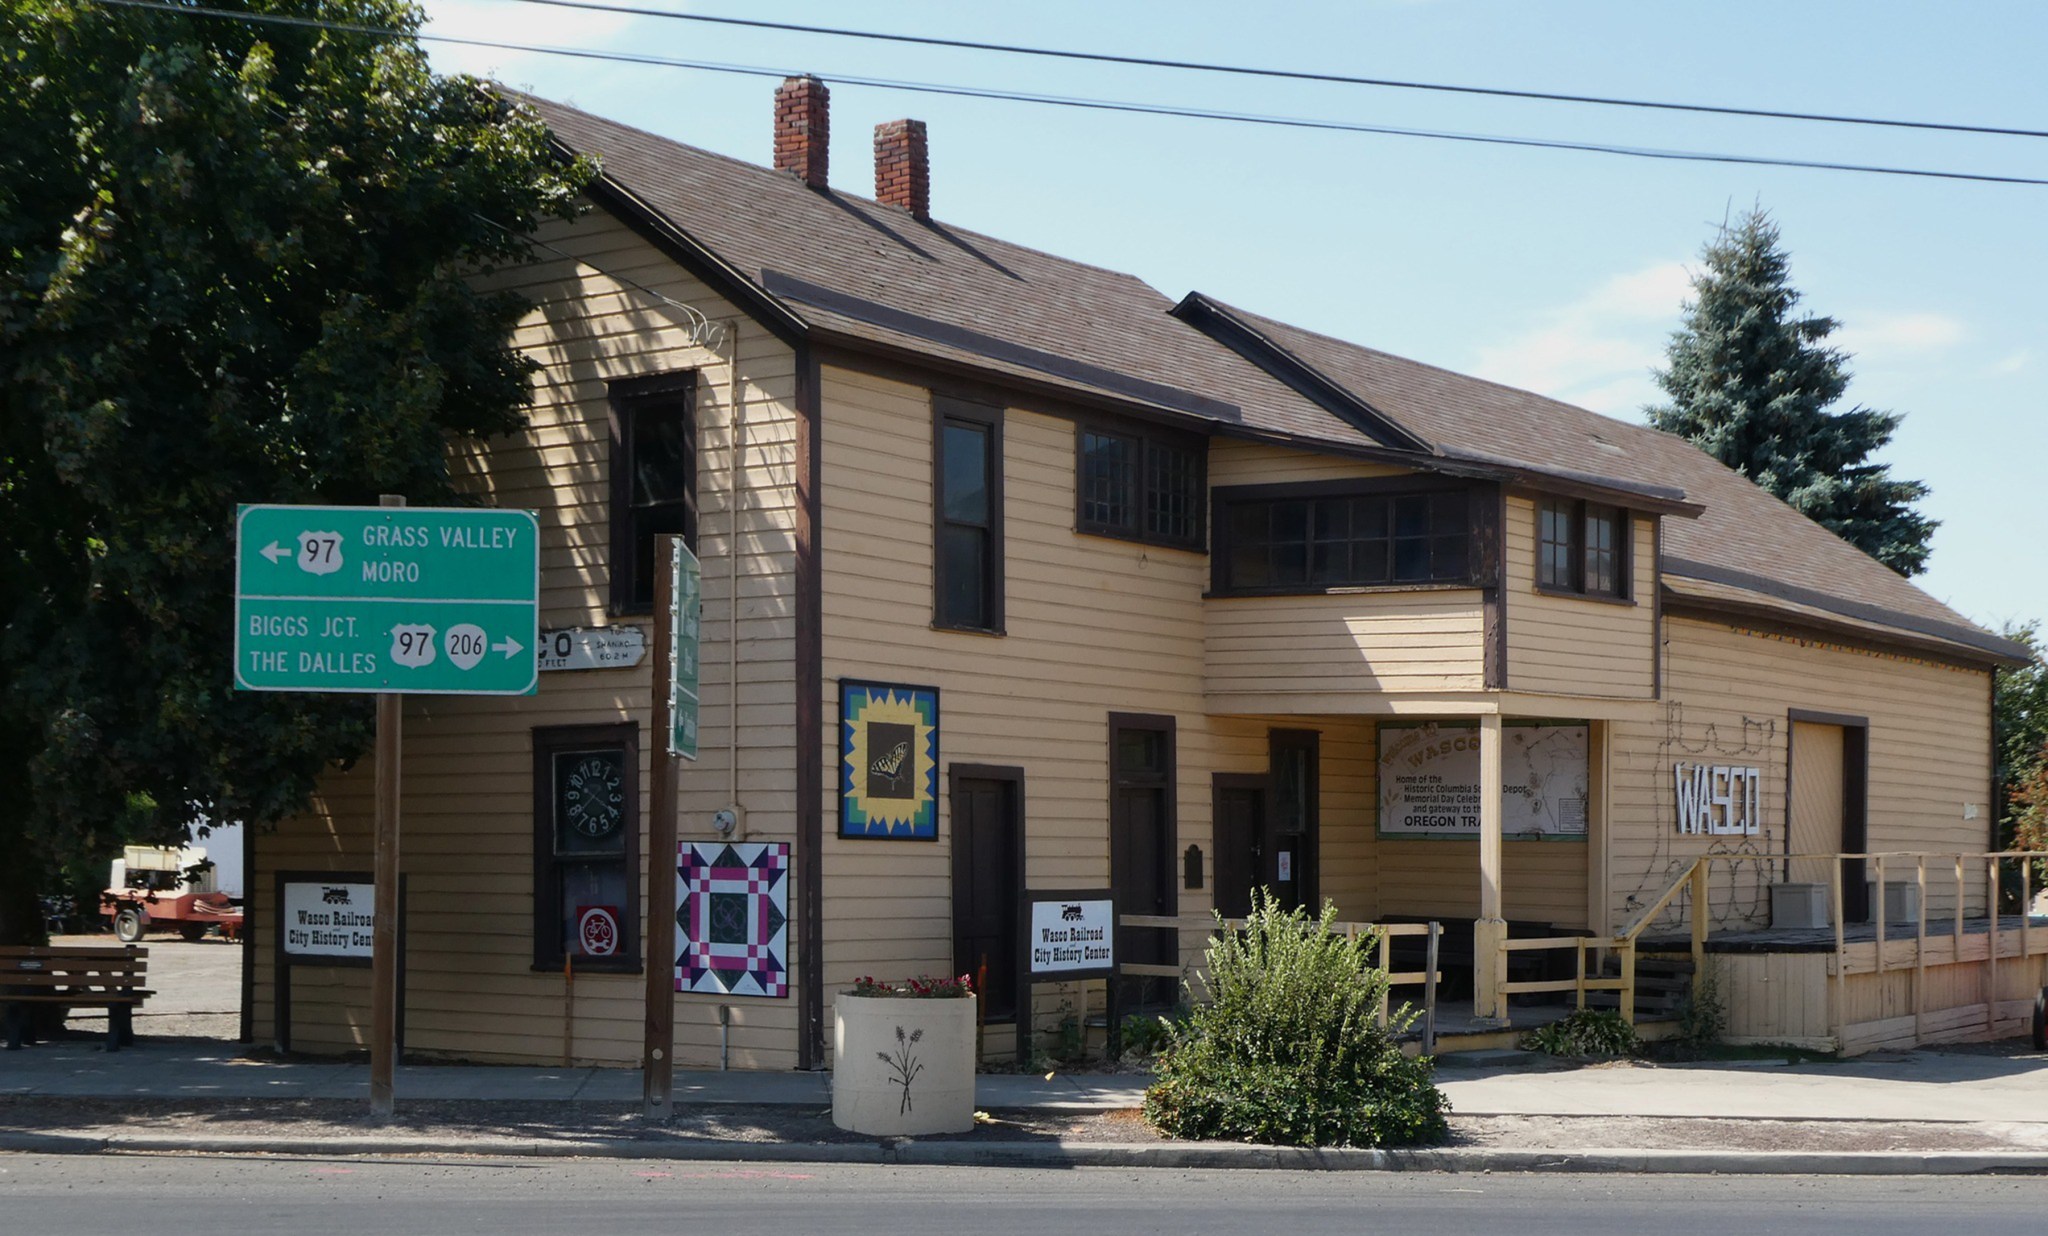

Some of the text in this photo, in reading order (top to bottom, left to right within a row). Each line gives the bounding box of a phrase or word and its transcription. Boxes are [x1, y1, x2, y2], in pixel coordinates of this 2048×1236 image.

[362, 525, 517, 549] GRASS VALLEY
[305, 538, 336, 564] 97
[362, 560, 420, 583] MORO
[250, 615, 360, 638] BIGGS JCT.
[399, 632, 429, 657] 97
[450, 634, 483, 656] 206
[250, 651, 376, 674] THE DALLES
[580, 763, 591, 779] 11
[591, 760, 601, 777] 12
[602, 765, 611, 780] 1
[570, 774, 584, 789] 10
[607, 777, 620, 791] 2
[1395, 775, 1443, 784] Home of the
[567, 790, 581, 801] 9
[1404, 785, 1435, 794] Historic
[1436, 785, 1472, 794] Columbia
[1503, 784, 1527, 794] Depot
[609, 793, 622, 802] 3
[1404, 795, 1440, 803] Memorial
[1441, 795, 1455, 805] Day
[1674, 763, 1760, 836] WASCO
[569, 803, 583, 817] 8
[607, 805, 618, 819] 4
[1413, 805, 1427, 813] and
[1429, 806, 1461, 815] gateway
[577, 813, 589, 828] 7
[589, 816, 598, 834] 6
[599, 814, 610, 830] 5
[1404, 816, 1456, 827] OREGON
[298, 910, 330, 926] Wasco
[289, 929, 374, 949] City History Cen
[1042, 926, 1103, 943] Wasco Railroad
[1034, 945, 1110, 965] City History Center
